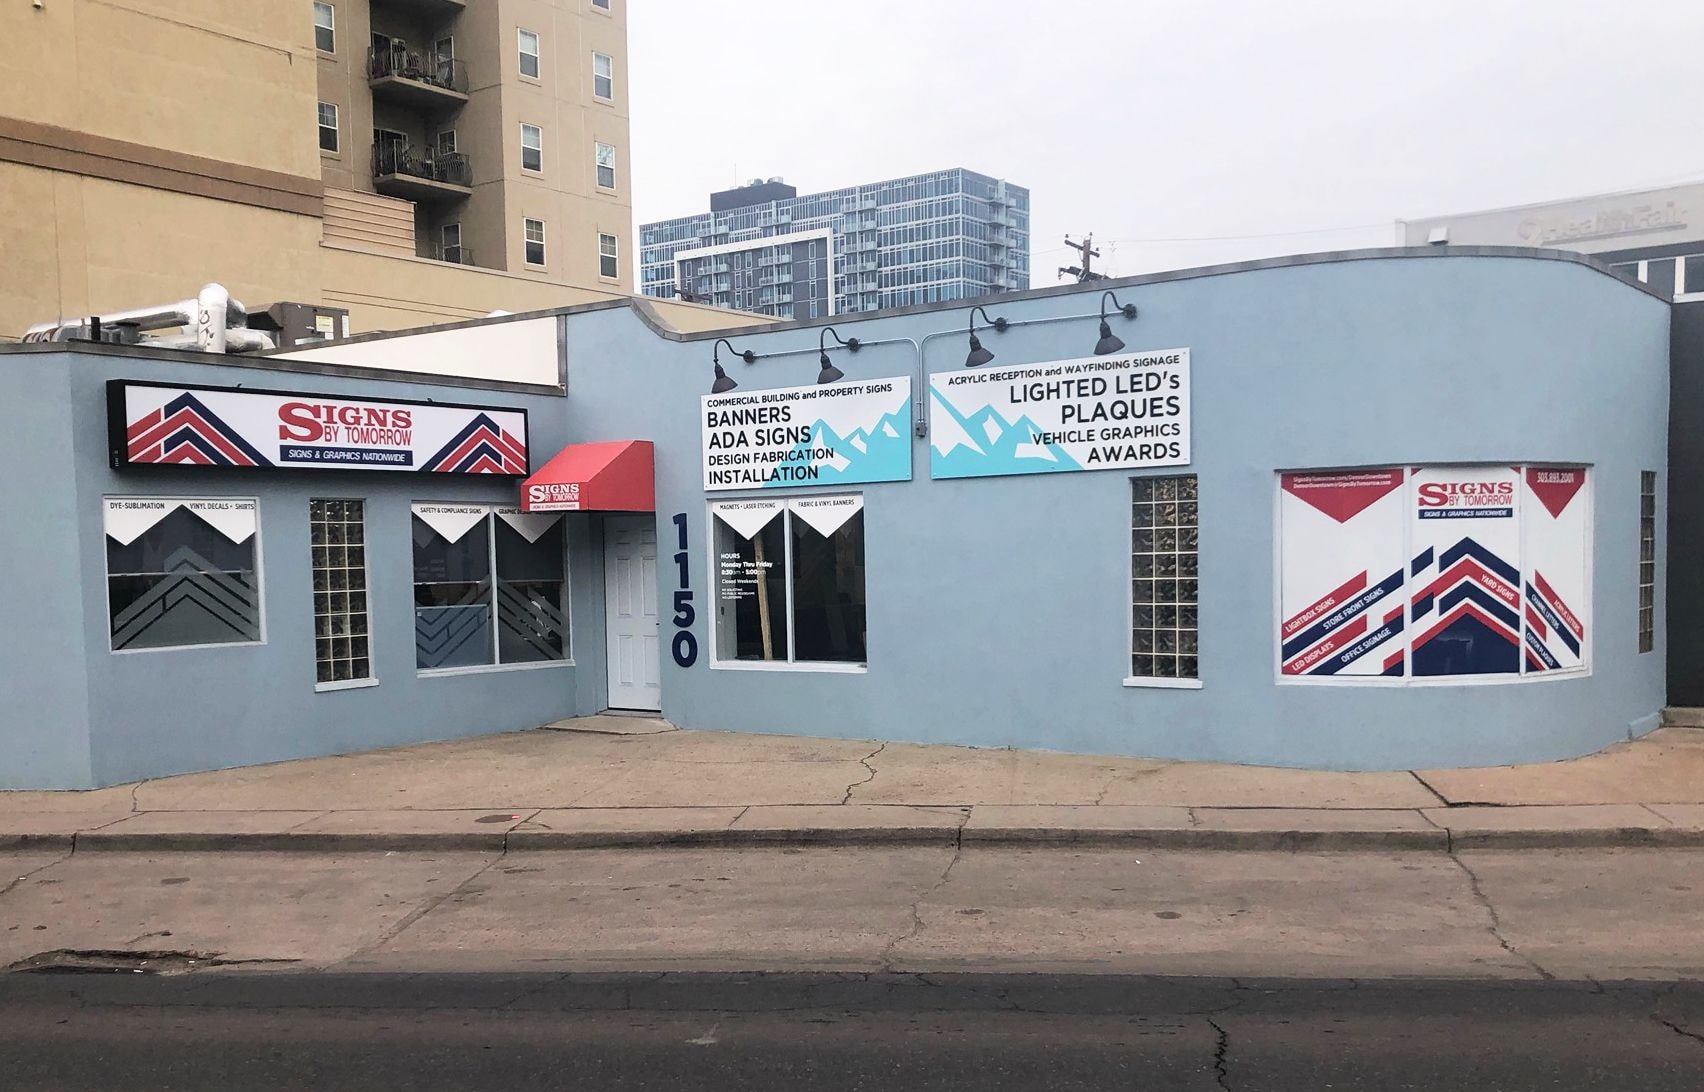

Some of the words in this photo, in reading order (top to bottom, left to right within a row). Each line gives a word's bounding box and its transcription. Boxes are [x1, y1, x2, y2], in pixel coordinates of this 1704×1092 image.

[948, 374, 987, 386] ACRYLIC
[990, 369, 1042, 382] RECEPTION
[1044, 366, 1062, 376] and
[1065, 360, 1130, 374] WAYFINDING
[1133, 354, 1180, 368] SIGNAGE
[707, 396, 760, 408] COMMERCIAL
[762, 392, 800, 403] BUILDING
[802, 391, 816, 400] and
[818, 386, 864, 398] PROPERTY
[866, 384, 892, 394] SIGNS
[1010, 377, 1107, 404] LIGHTED
[1116, 371, 1180, 394] LED's
[278, 402, 412, 442] SIGNS
[707, 406, 791, 428] BANNERS
[1062, 396, 1180, 424] PLAQUES
[324, 426, 339, 442] BY
[345, 426, 412, 446] TOMORROW
[708, 429, 749, 450] ADA
[755, 425, 812, 446] SIGNS
[1032, 429, 1096, 446] VEHICLE
[1100, 423, 1181, 440] GRAPHICS
[288, 449, 312, 458] SIGNS
[314, 450, 320, 458] &
[323, 450, 360, 460] GRAPHICS
[362, 452, 405, 462] NATIONWIDE
[708, 453, 750, 466] DESIGN
[754, 448, 834, 464] FABRICATION
[1087, 442, 1181, 464] AWARDS
[708, 465, 819, 484] INSTALLATION
[528, 483, 580, 502] SIGNS
[1418, 482, 1513, 507] SIGNS
[1448, 495, 1460, 506] BY
[1464, 494, 1512, 506] TOMORROW
[110, 502, 165, 510] DYE-SUBLIMATION
[672, 512, 698, 668] 1150
[1480, 574, 1497, 589] YARD
[1496, 586, 1515, 601] SIGNS
[1285, 610, 1316, 633] LIGHTBOX
[1315, 596, 1335, 613] SIGNS
[1322, 612, 1344, 630] STORE
[1342, 600, 1364, 618] FRONT
[1364, 587, 1384, 604] SIGNS
[1291, 660, 1305, 672] LED
[1304, 640, 1335, 664] DISPLAYS
[1340, 644, 1365, 663] OFFICE
[1362, 627, 1392, 649] SIGNAGE
